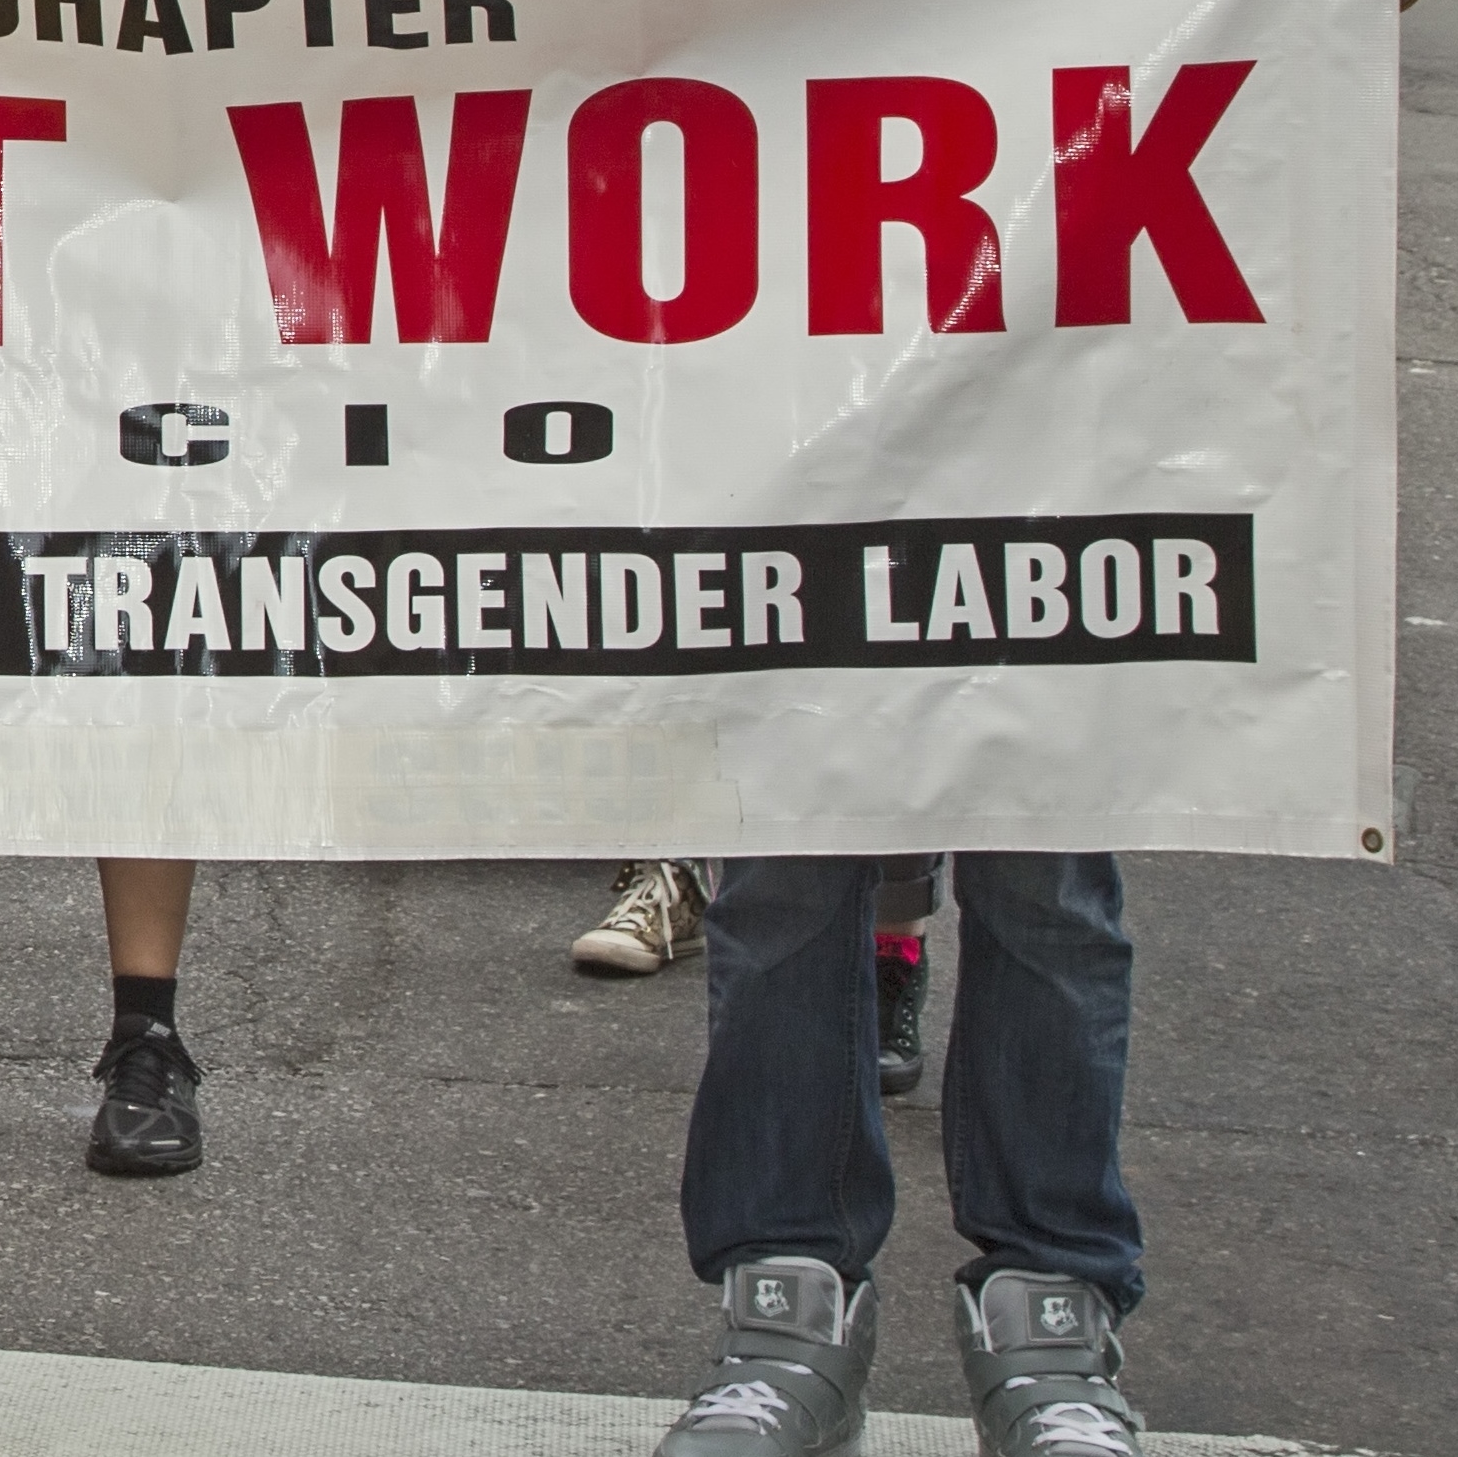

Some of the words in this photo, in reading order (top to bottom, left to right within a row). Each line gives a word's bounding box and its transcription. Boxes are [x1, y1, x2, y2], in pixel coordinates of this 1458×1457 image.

[226, 60, 1268, 345] WORK
[25, 550, 805, 654] TRANSGENDER
[863, 538, 1221, 642] LABOR
